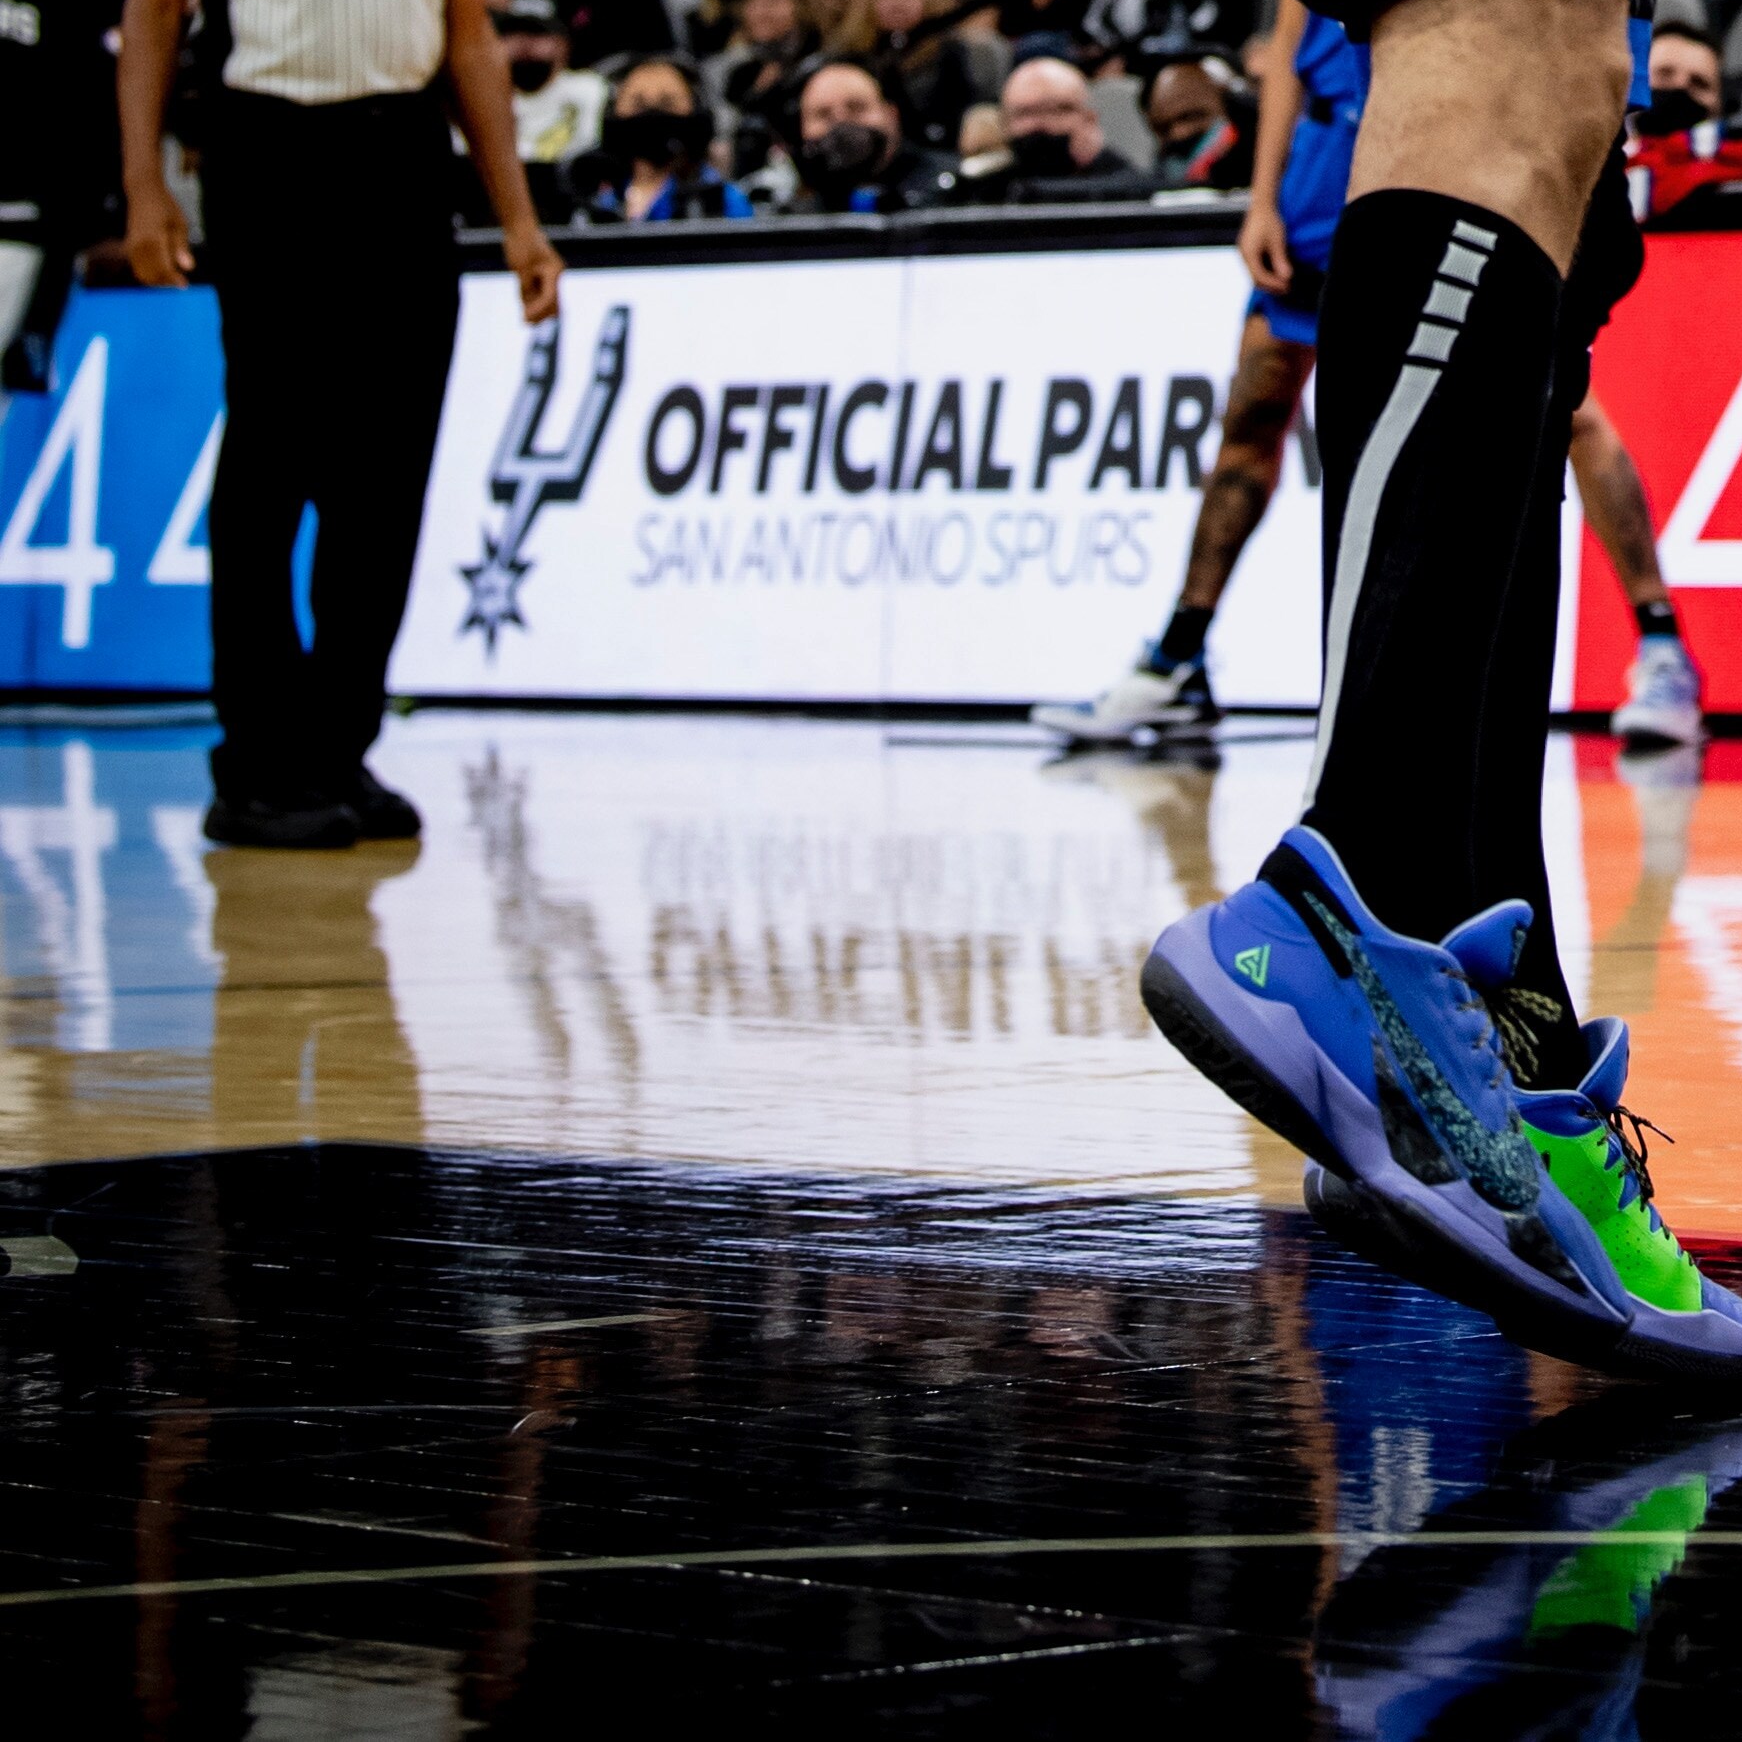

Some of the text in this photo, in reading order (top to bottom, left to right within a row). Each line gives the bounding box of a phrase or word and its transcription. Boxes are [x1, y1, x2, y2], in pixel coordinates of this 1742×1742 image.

[644, 374, 1322, 497] OFFICIAL PAR
[631, 509, 1155, 588] SAN ANTONIO SPURS
